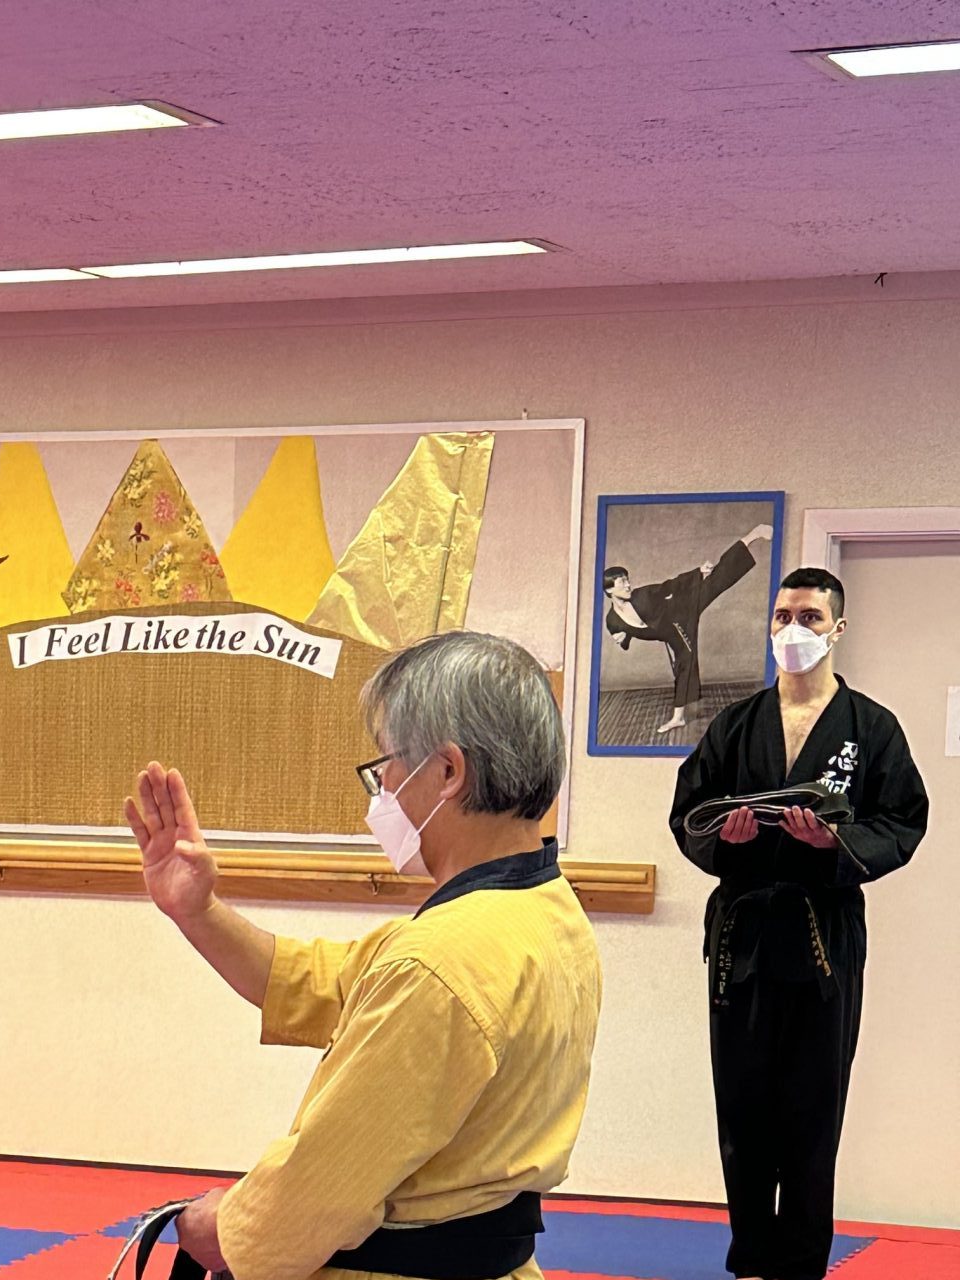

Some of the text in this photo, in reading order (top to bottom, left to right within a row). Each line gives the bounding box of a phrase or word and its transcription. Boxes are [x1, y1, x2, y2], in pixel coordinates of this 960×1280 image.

[17, 620, 322, 667] I Feel Like the Sun
